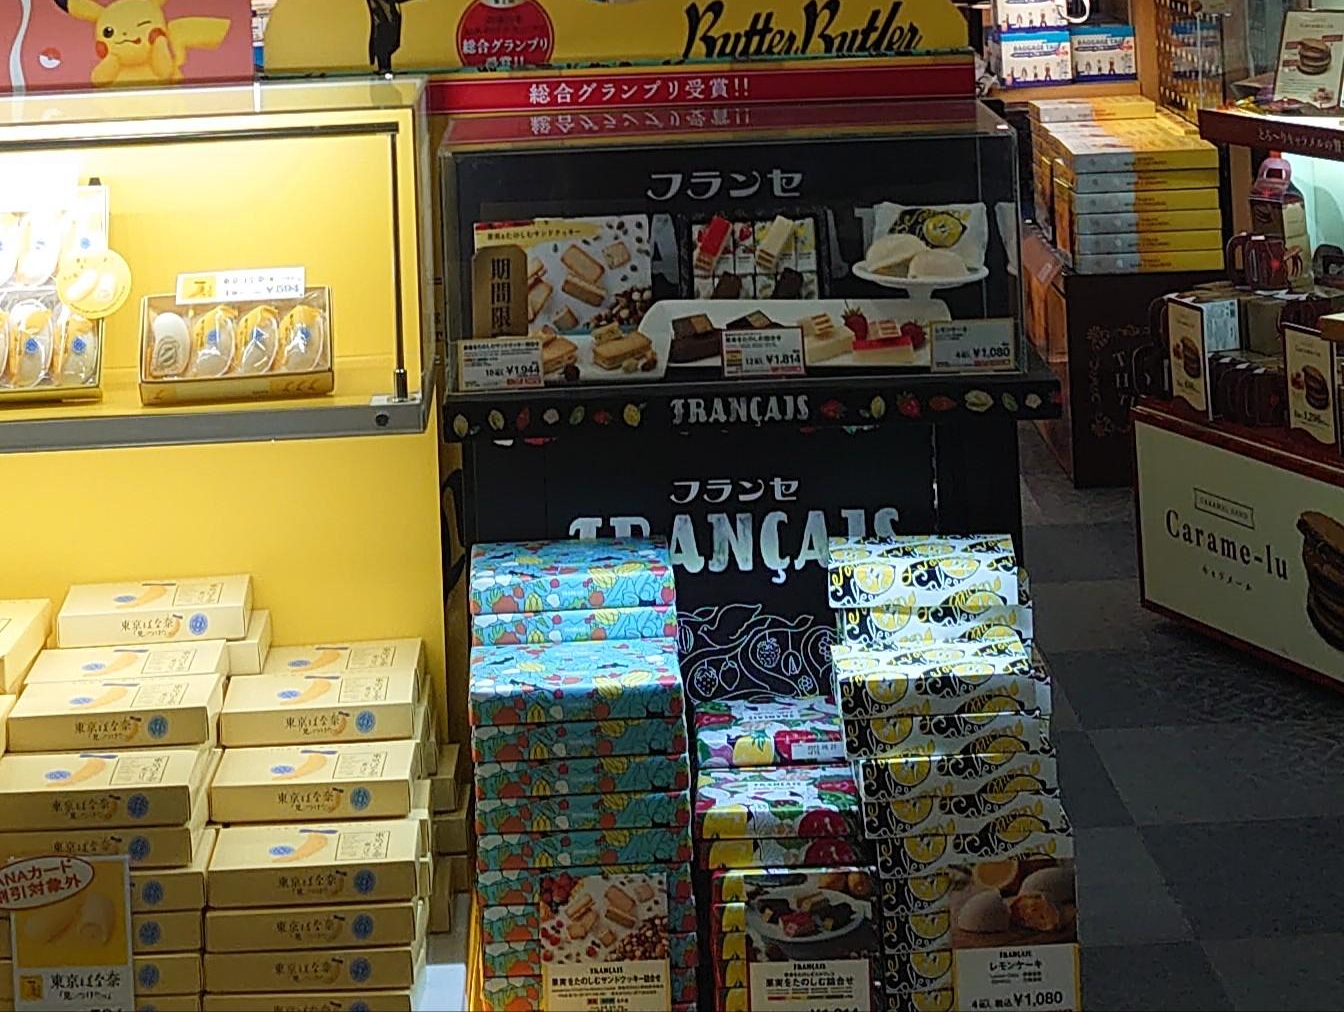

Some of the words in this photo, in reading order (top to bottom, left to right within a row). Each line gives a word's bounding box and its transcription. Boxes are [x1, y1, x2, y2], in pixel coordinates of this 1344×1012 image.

[463, 39, 549, 55] 総合グランプリ
[529, 77, 751, 104] 総合グランプリ受賞!!
[648, 169, 803, 200] フランセ
[491, 258, 512, 336] 期間限
[670, 395, 809, 428] FRANÇAIS
[670, 478, 800, 502] フランセ
[1166, 509, 1288, 581] Carame-lu
[121, 617, 173, 631] 東京ばな奈
[75, 720, 131, 734] 東京ばな奈
[285, 715, 340, 730] 東京ばな奈
[989, 960, 1043, 971] レモンケーキ
[50, 972, 121, 988] 東京ばな奈
[1013, 991, 1064, 1008] ¥1,080
